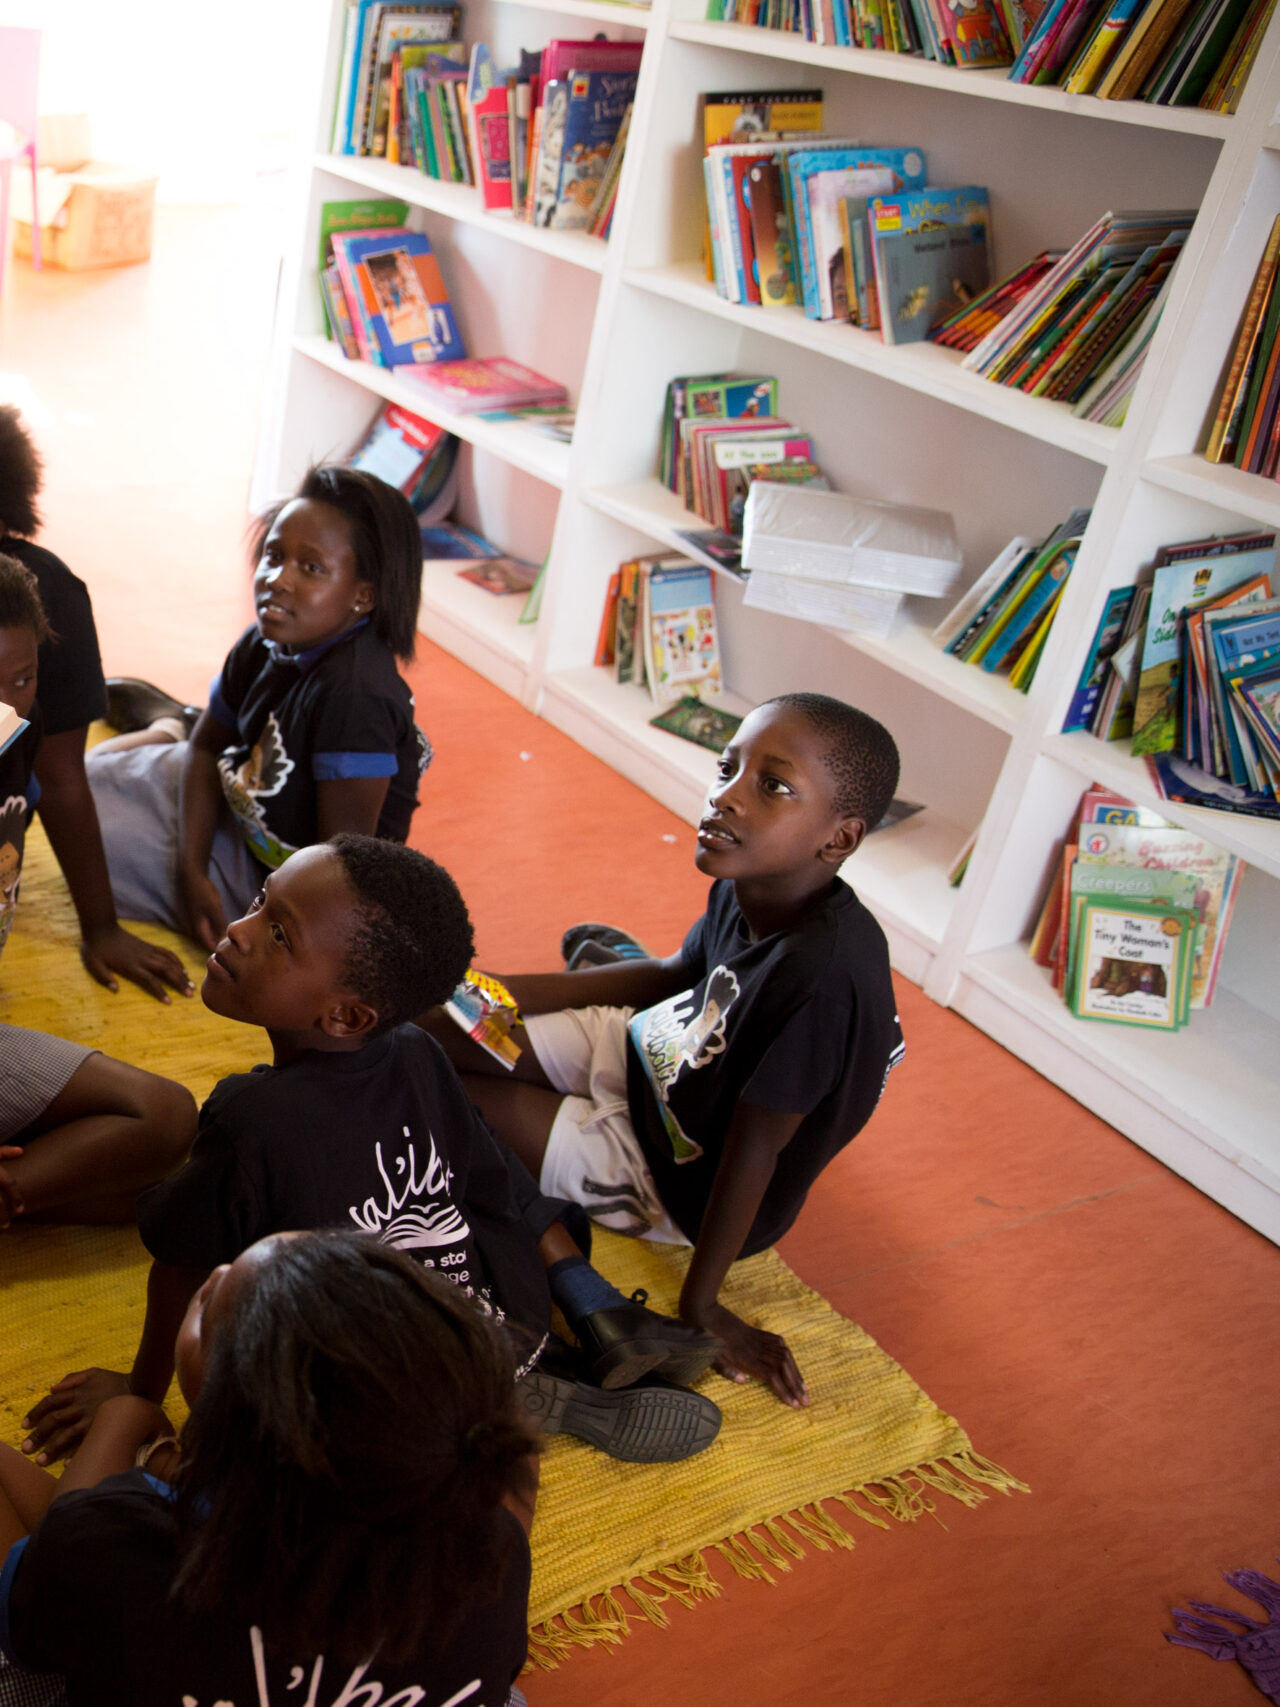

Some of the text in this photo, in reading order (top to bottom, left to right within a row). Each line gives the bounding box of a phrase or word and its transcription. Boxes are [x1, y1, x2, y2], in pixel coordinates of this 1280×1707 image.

[1078, 872, 1153, 893] Creepers
[1124, 919, 1142, 931] The
[1095, 928, 1169, 949] Tiny Woman's
[1119, 945, 1143, 958] Coat
